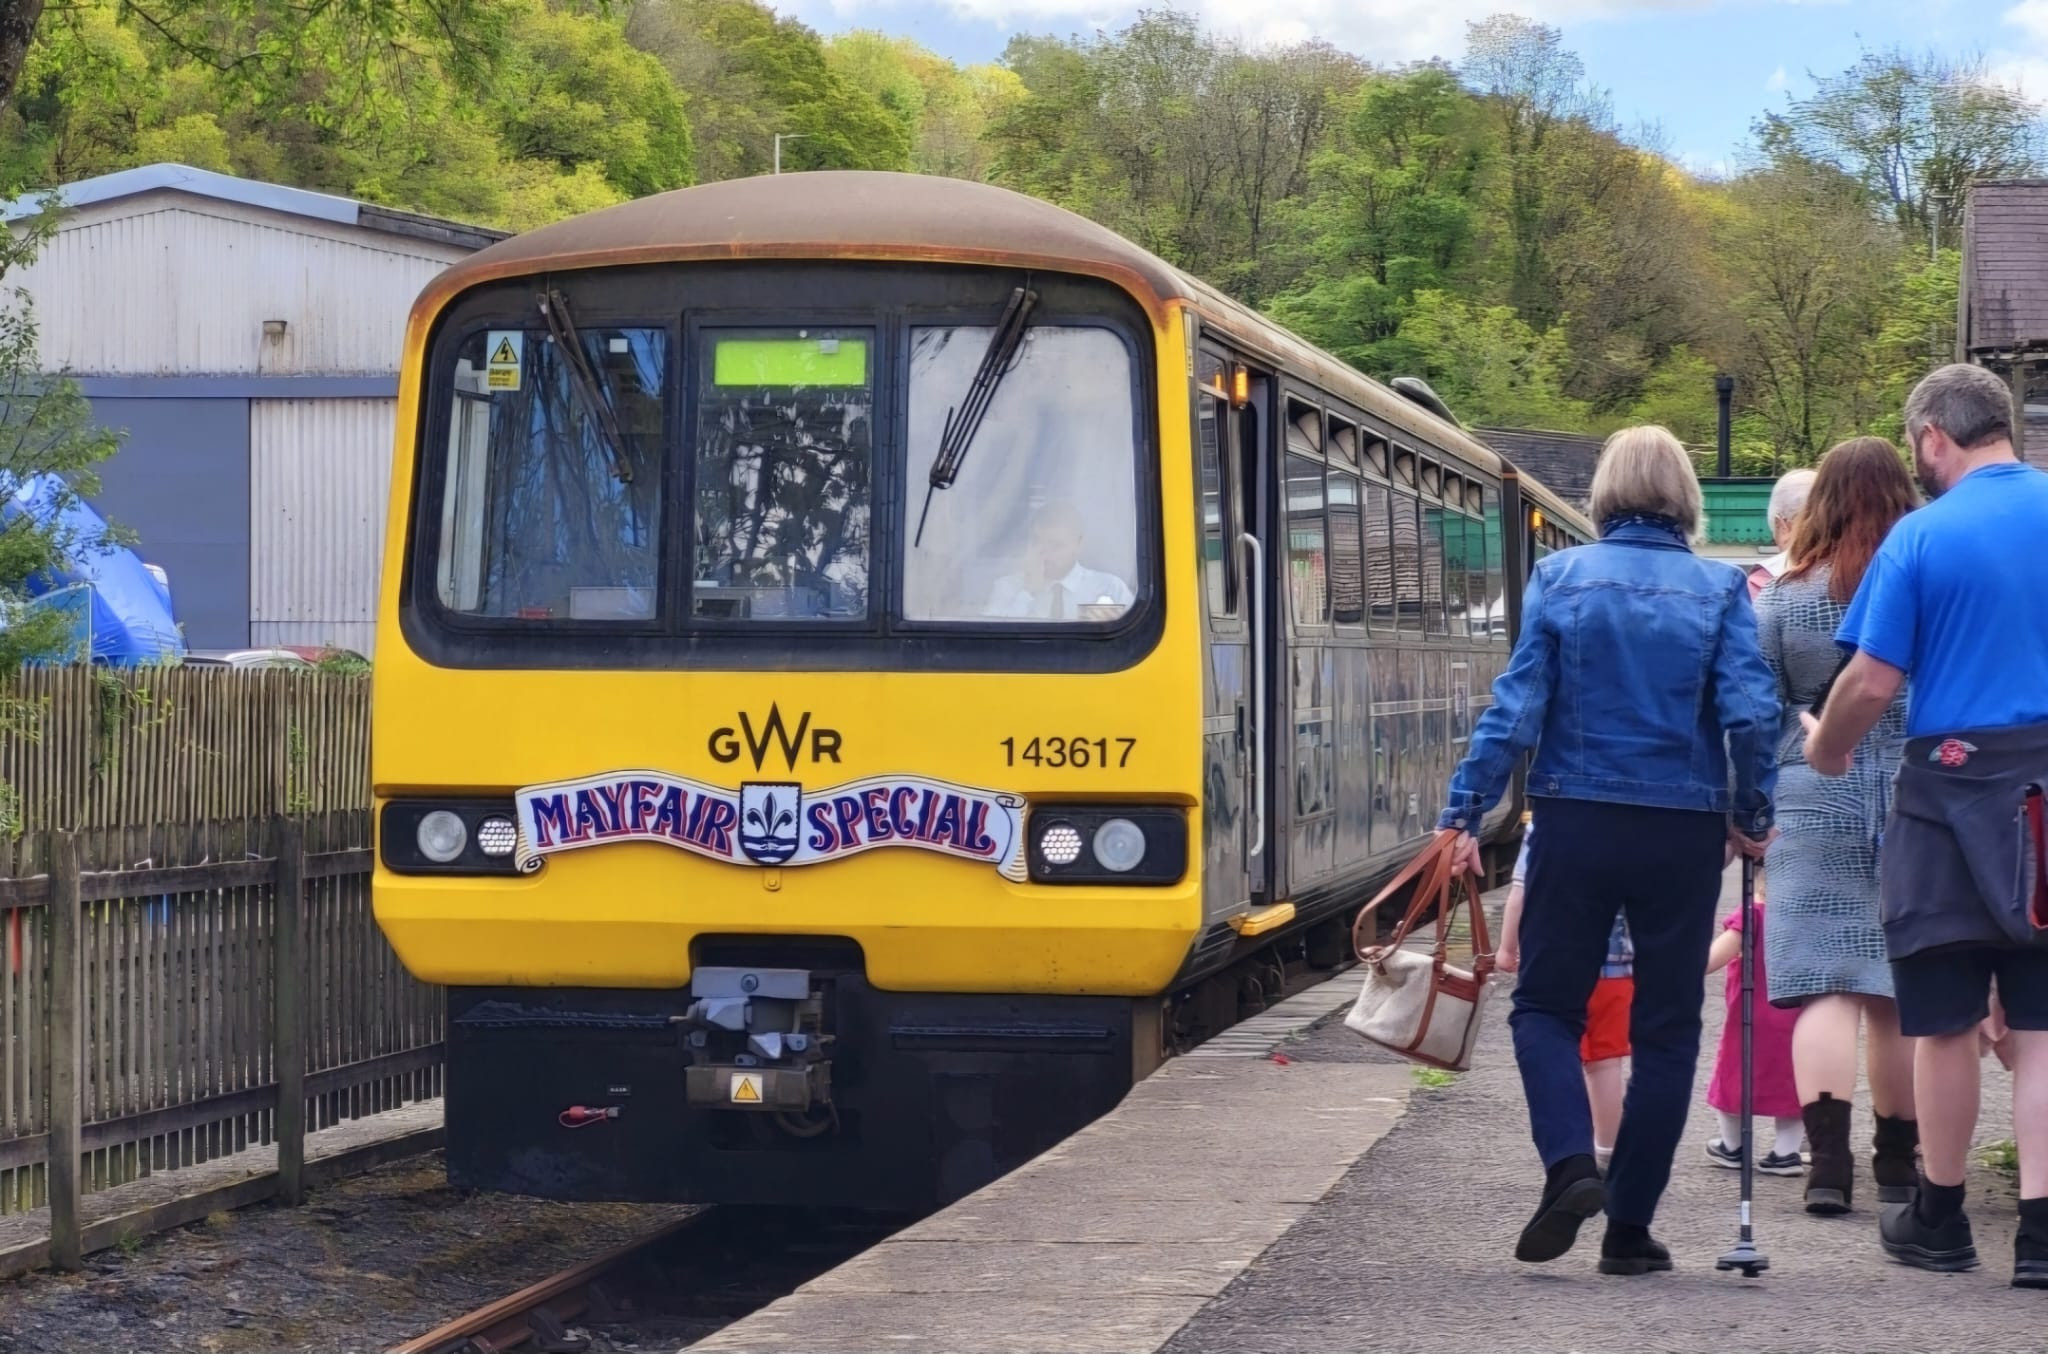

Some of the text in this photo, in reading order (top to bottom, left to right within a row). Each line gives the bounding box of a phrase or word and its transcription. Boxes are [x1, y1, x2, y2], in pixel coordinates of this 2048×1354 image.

[708, 700, 842, 774] GWR
[1000, 736, 1137, 768] 143617
[530, 781, 997, 858] MAYFAIR SPECIAL
